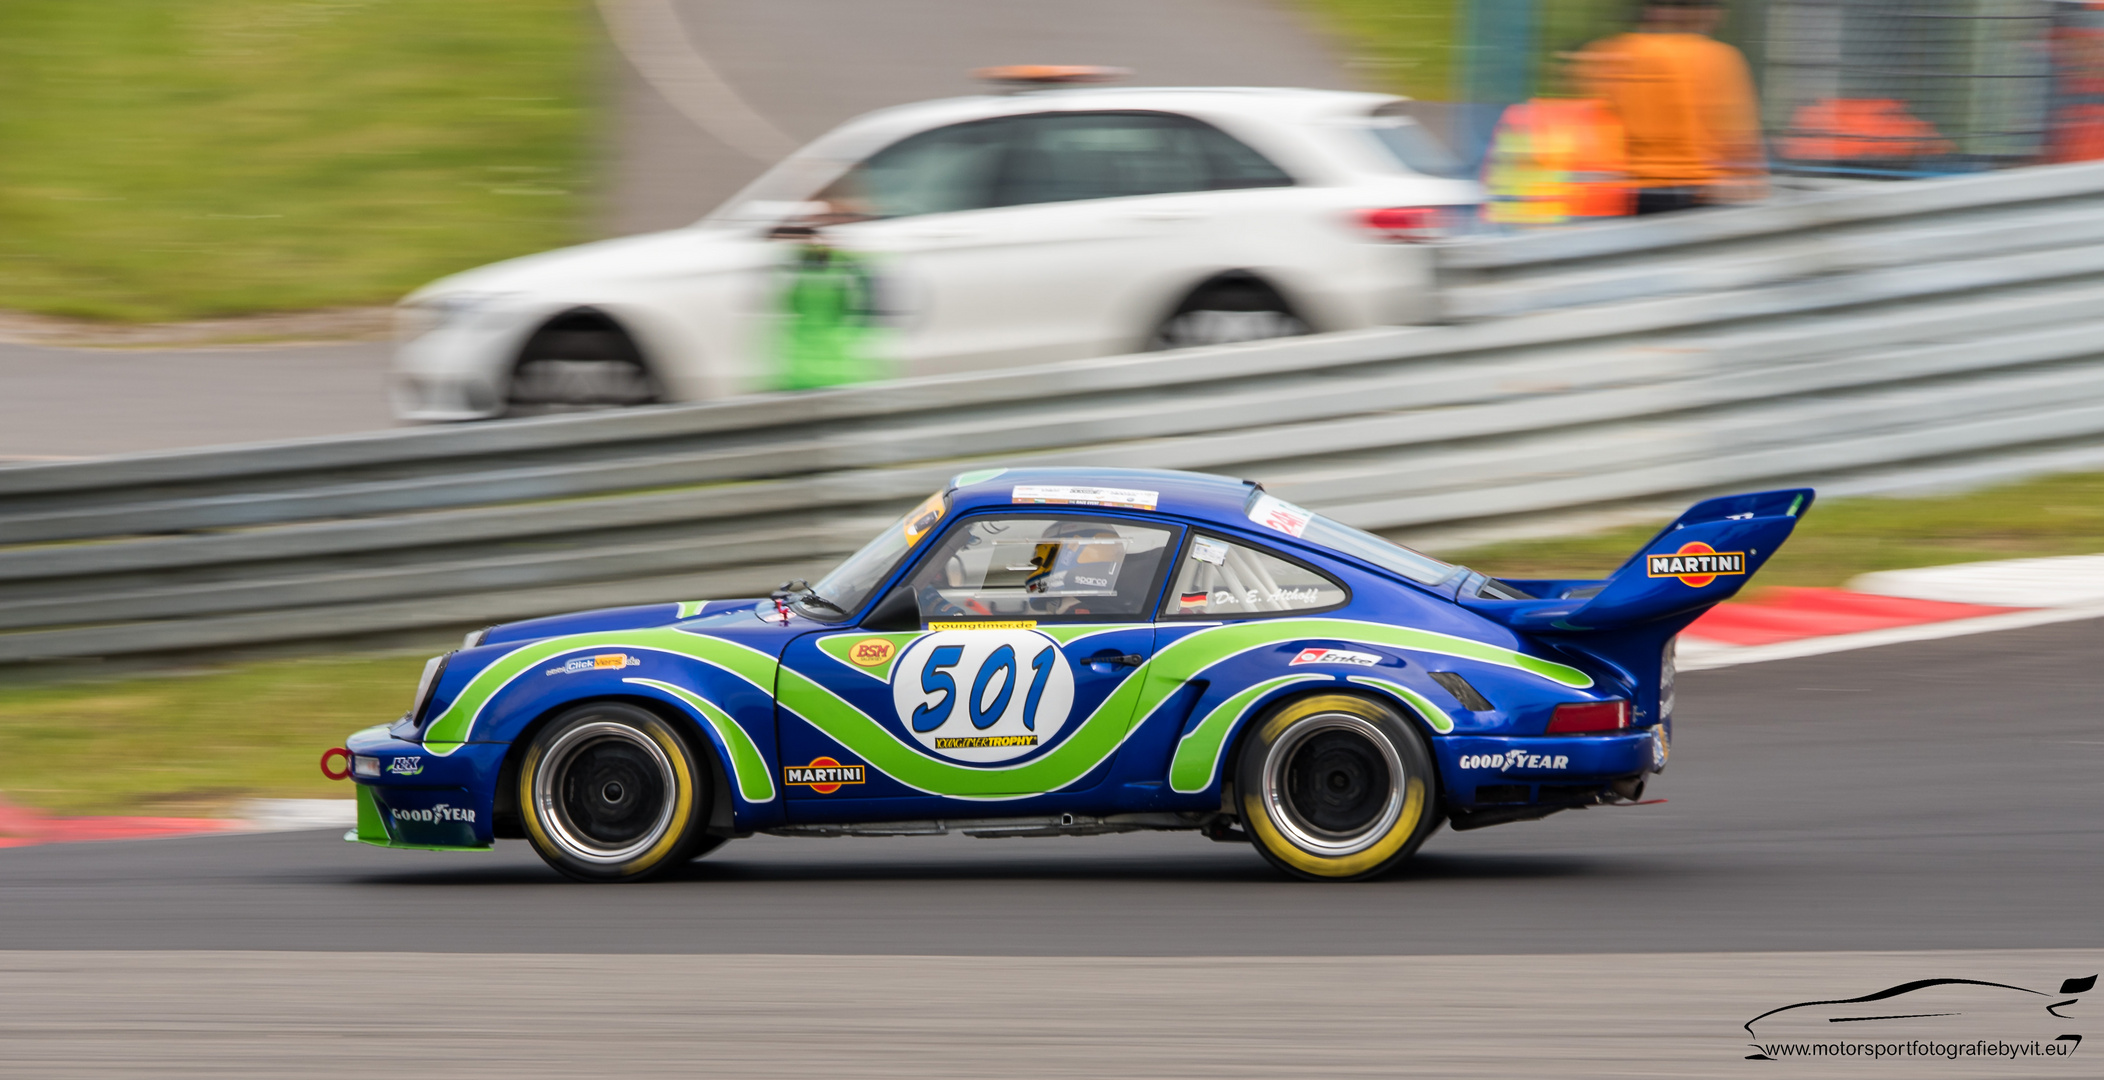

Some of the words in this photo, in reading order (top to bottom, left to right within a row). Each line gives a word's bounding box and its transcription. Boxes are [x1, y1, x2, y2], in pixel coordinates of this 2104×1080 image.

[1652, 555, 1740, 573] MARTINI
[1075, 575, 1107, 587] sparco
[1214, 591, 1239, 605] Dr.
[1245, 589, 1262, 604] E.
[1267, 588, 1319, 604] Althoff
[933, 621, 1033, 631] youngtimer.de
[857, 645, 890, 657] BSM
[912, 644, 1056, 733] 501
[788, 768, 861, 782] MARTINI
